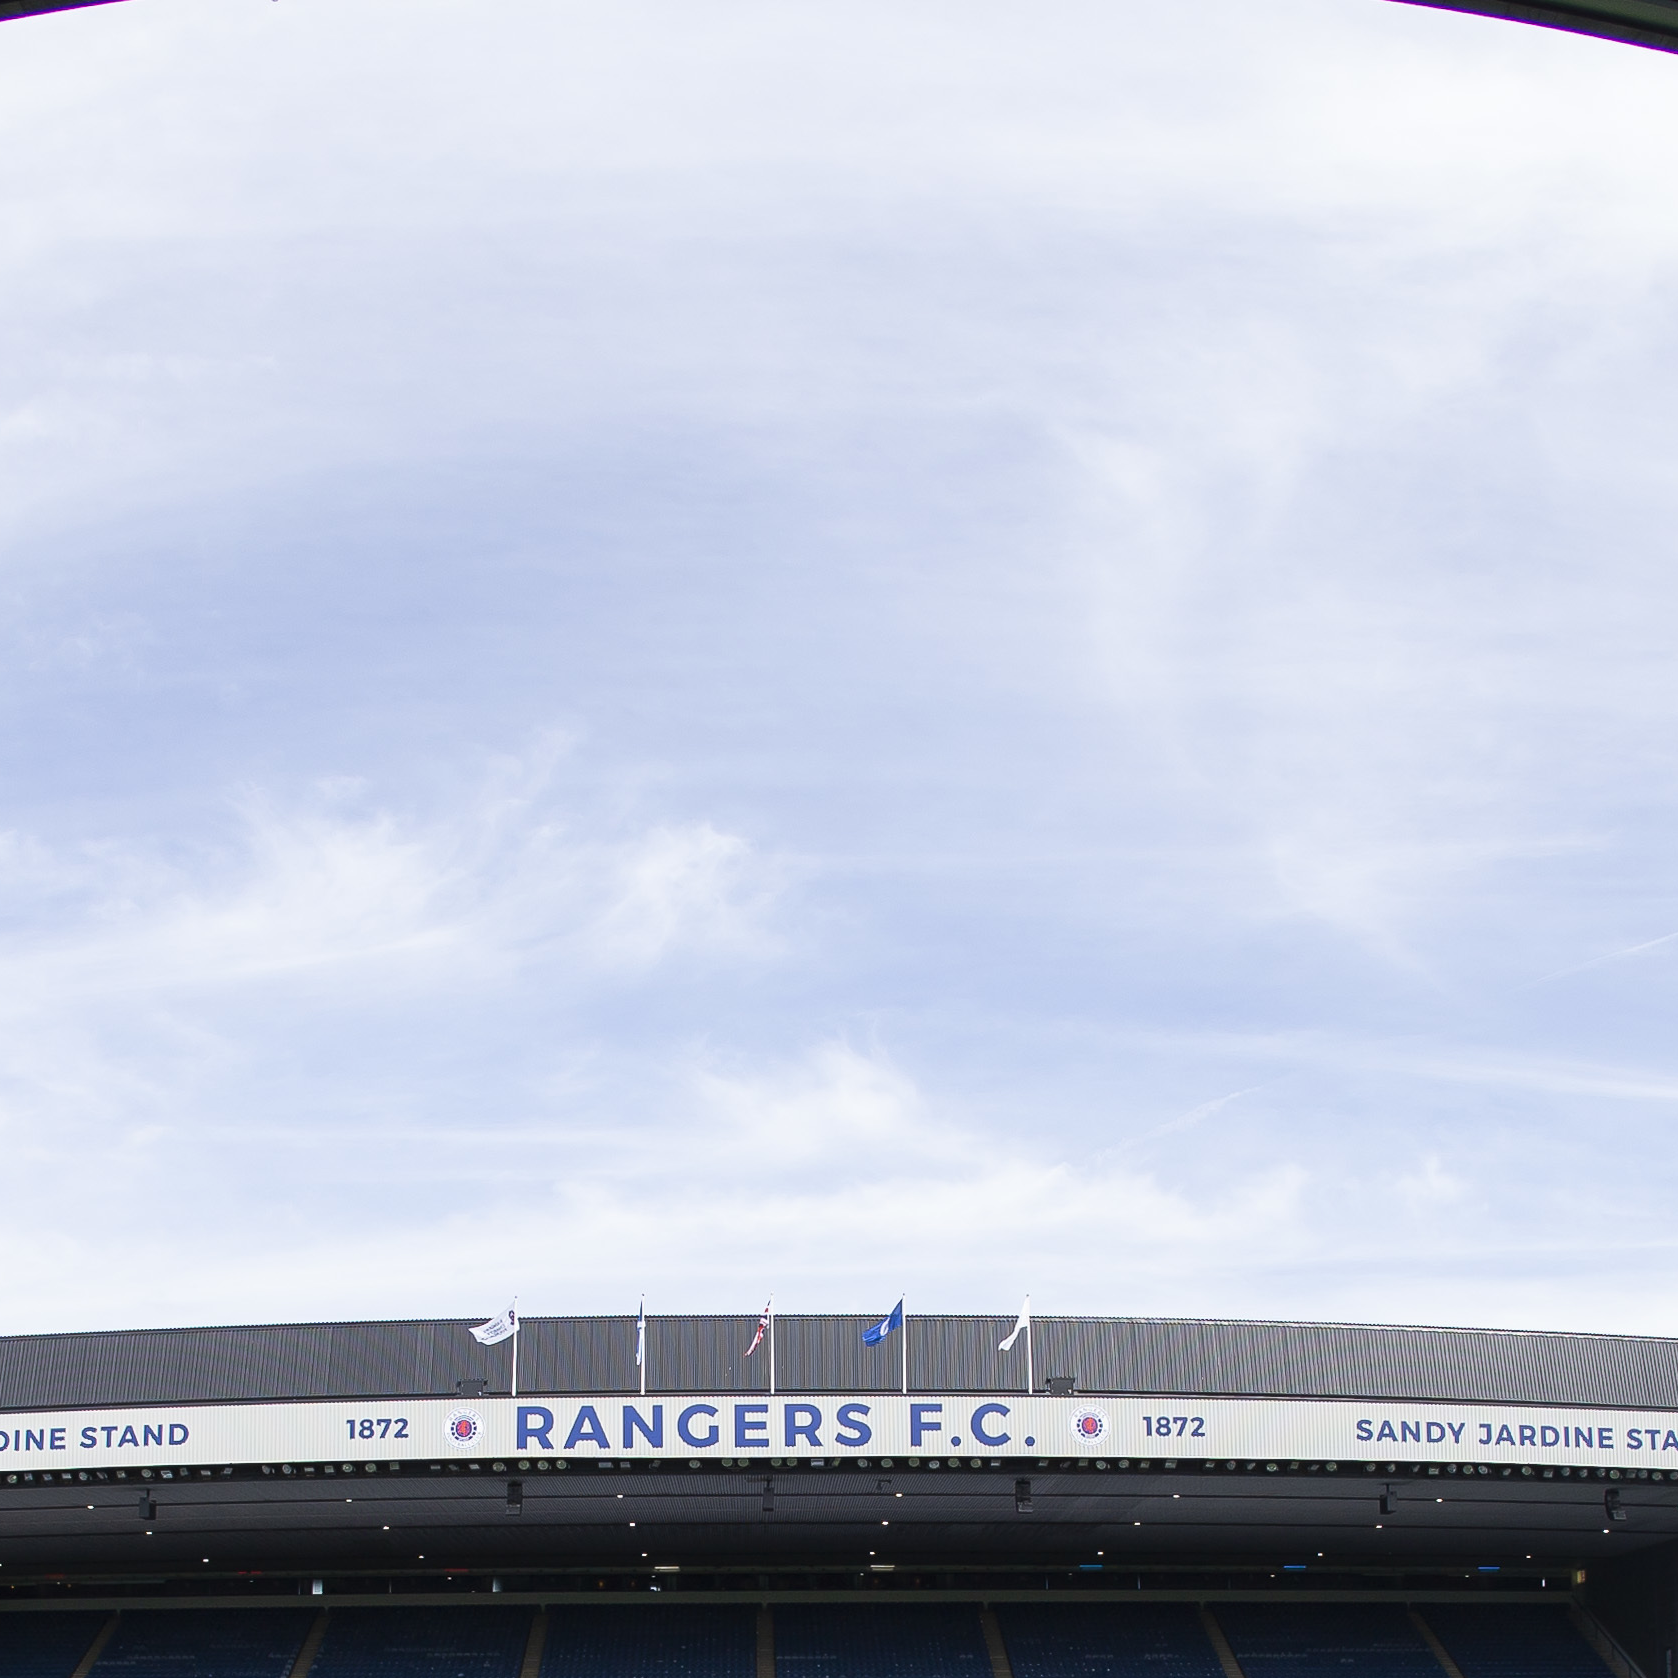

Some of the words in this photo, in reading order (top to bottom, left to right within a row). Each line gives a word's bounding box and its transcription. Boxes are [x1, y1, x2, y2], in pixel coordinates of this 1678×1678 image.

[79, 1423, 190, 1449] STAND
[346, 1418, 409, 1440] 1872
[516, 1403, 872, 1450] RANGERS
[910, 1403, 1036, 1448] F.C.
[1143, 1416, 1206, 1437] 1872
[1356, 1419, 1467, 1444] SANDY
[1478, 1422, 1615, 1450] JARDINE
